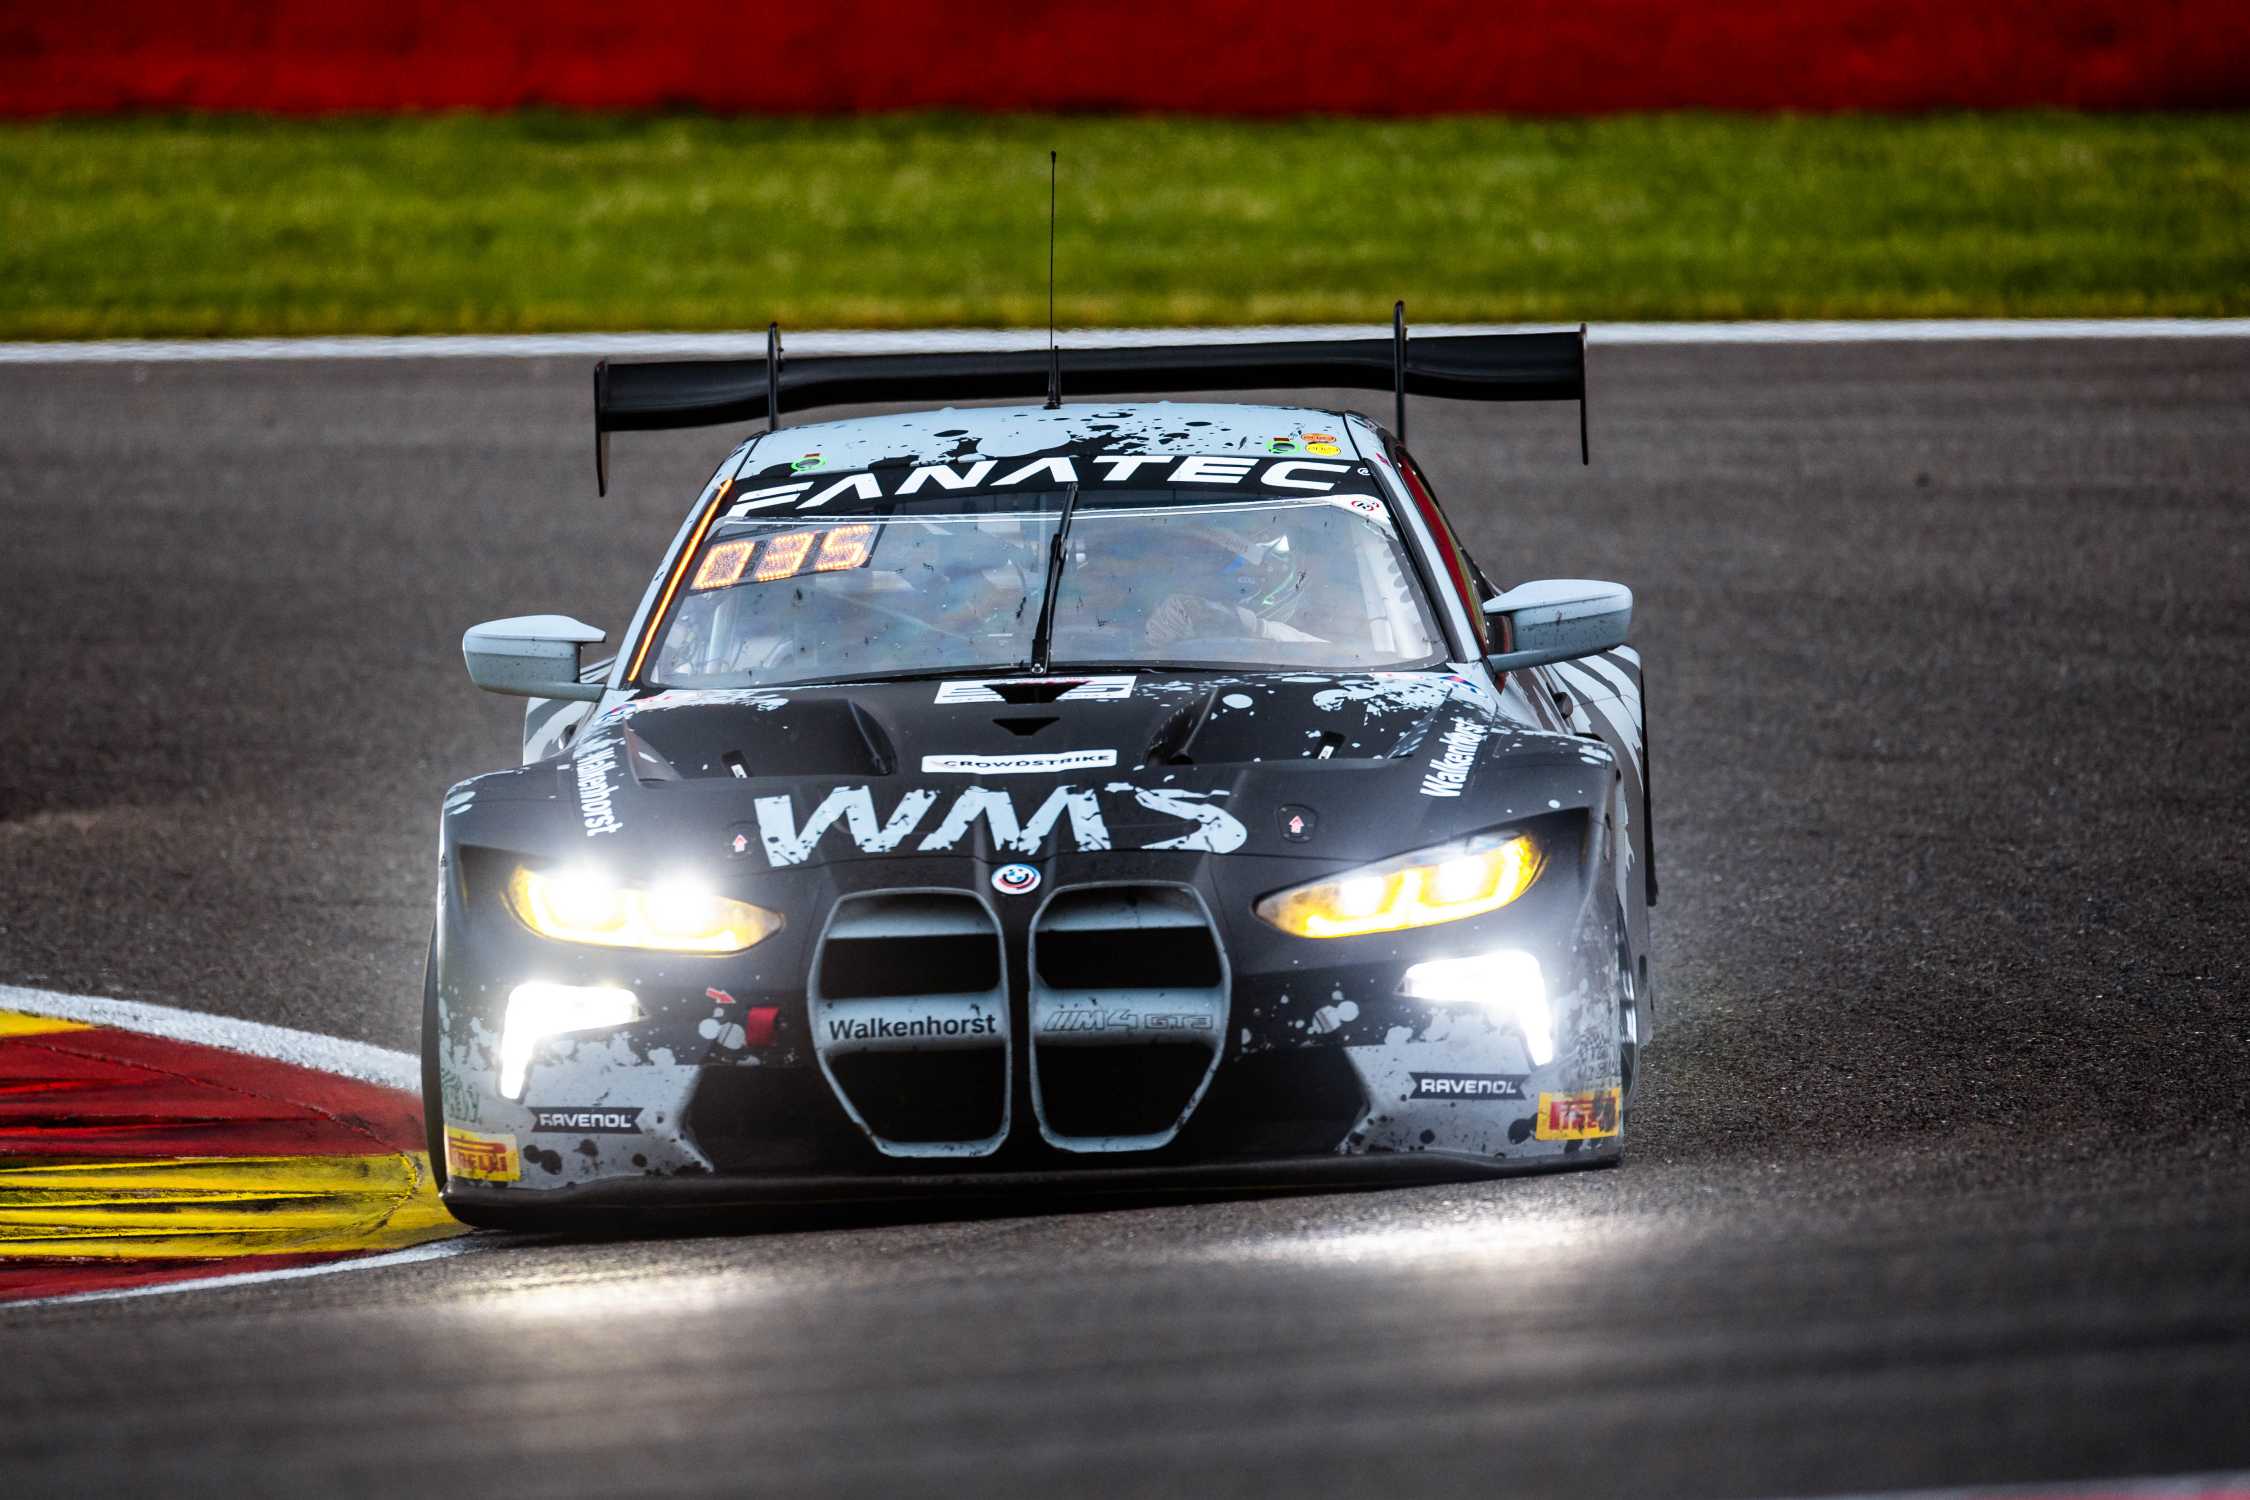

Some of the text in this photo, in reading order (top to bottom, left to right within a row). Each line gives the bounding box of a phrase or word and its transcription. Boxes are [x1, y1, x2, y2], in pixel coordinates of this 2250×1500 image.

[726, 454, 1352, 517] FANATEC
[943, 754, 1111, 769] CROWDSTRIKE
[754, 784, 1248, 868] WMS
[829, 1014, 996, 1041] Walkenhorst
[1421, 1078, 1516, 1095] RAVENOL
[539, 1112, 631, 1129] RAVENOL
